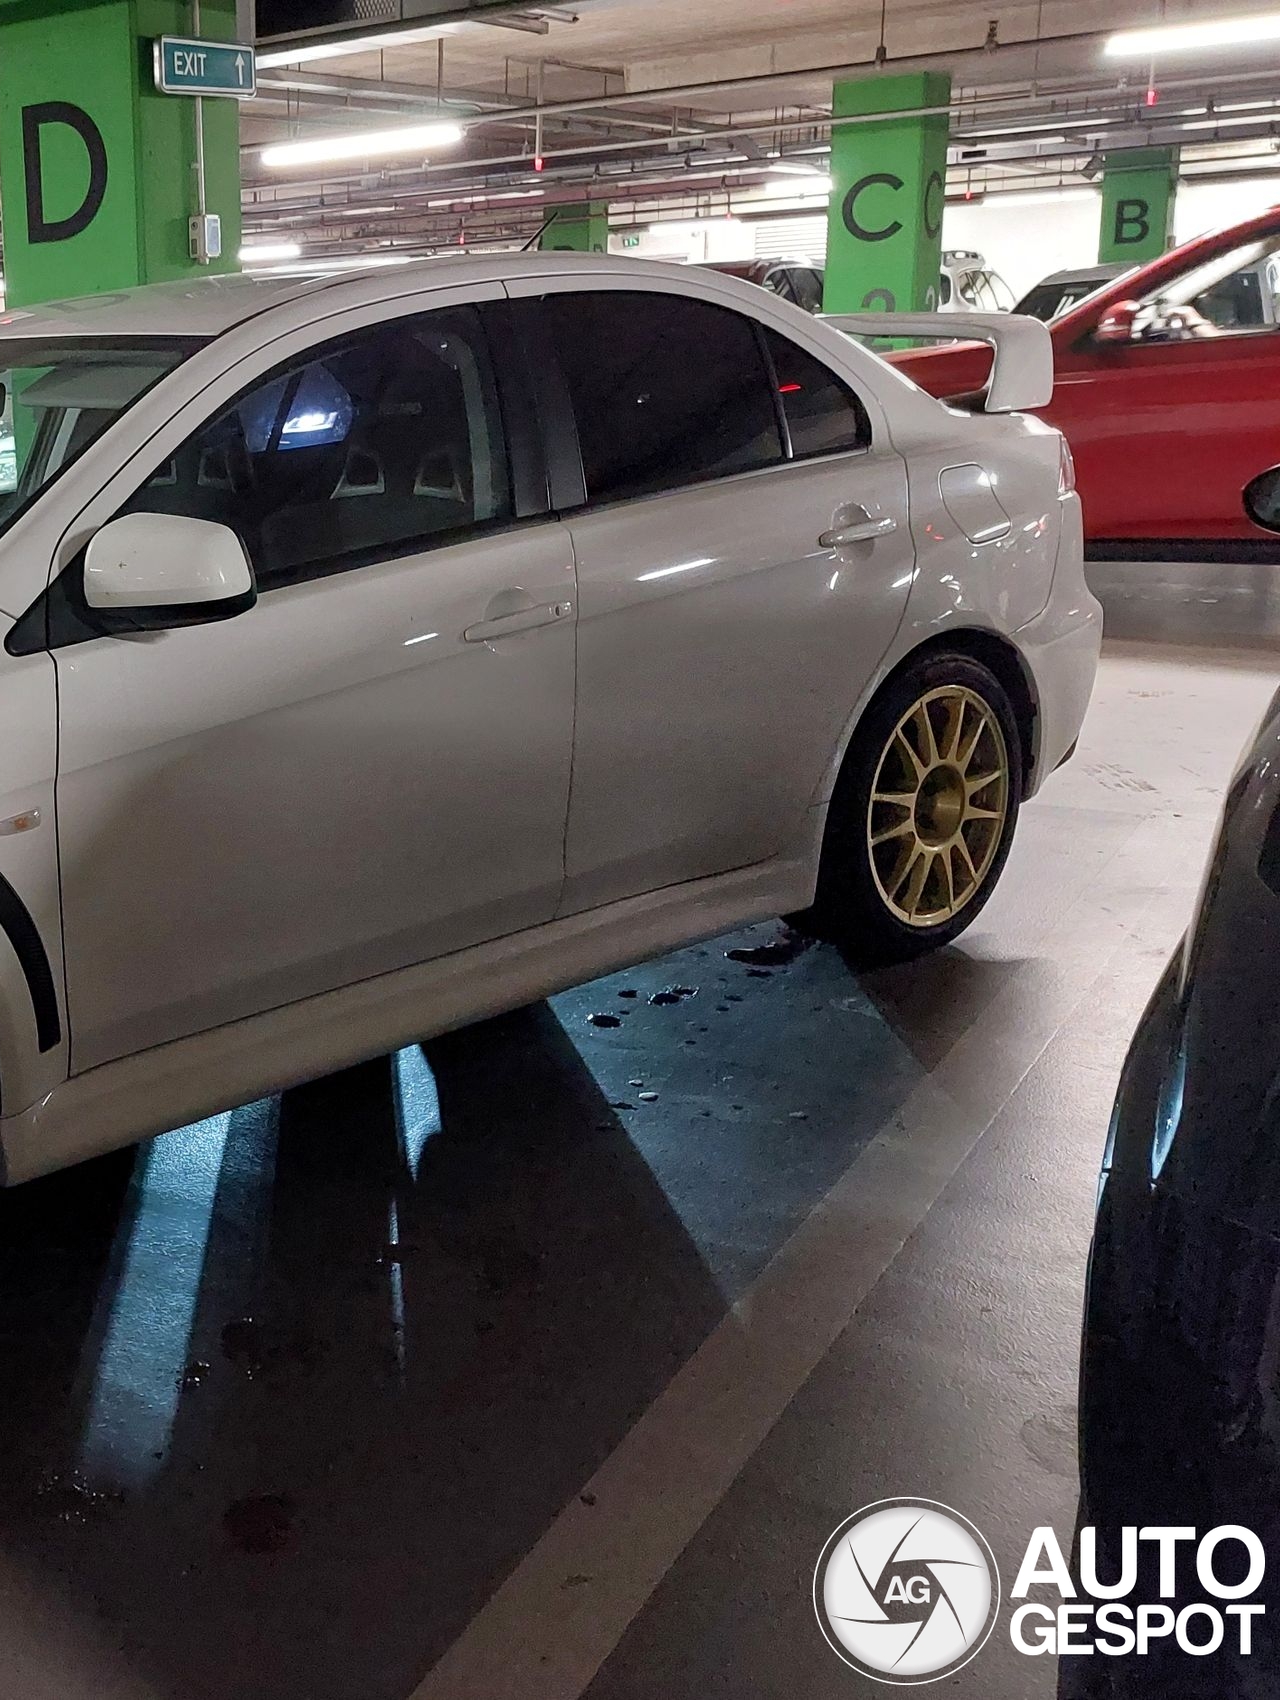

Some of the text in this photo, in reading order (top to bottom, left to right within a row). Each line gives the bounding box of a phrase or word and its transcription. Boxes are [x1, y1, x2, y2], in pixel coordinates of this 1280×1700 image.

[173, 51, 207, 77] EXIT
[21, 101, 108, 244] D
[924, 170, 942, 239] C
[841, 173, 904, 242] C
[1114, 199, 1149, 244] B
